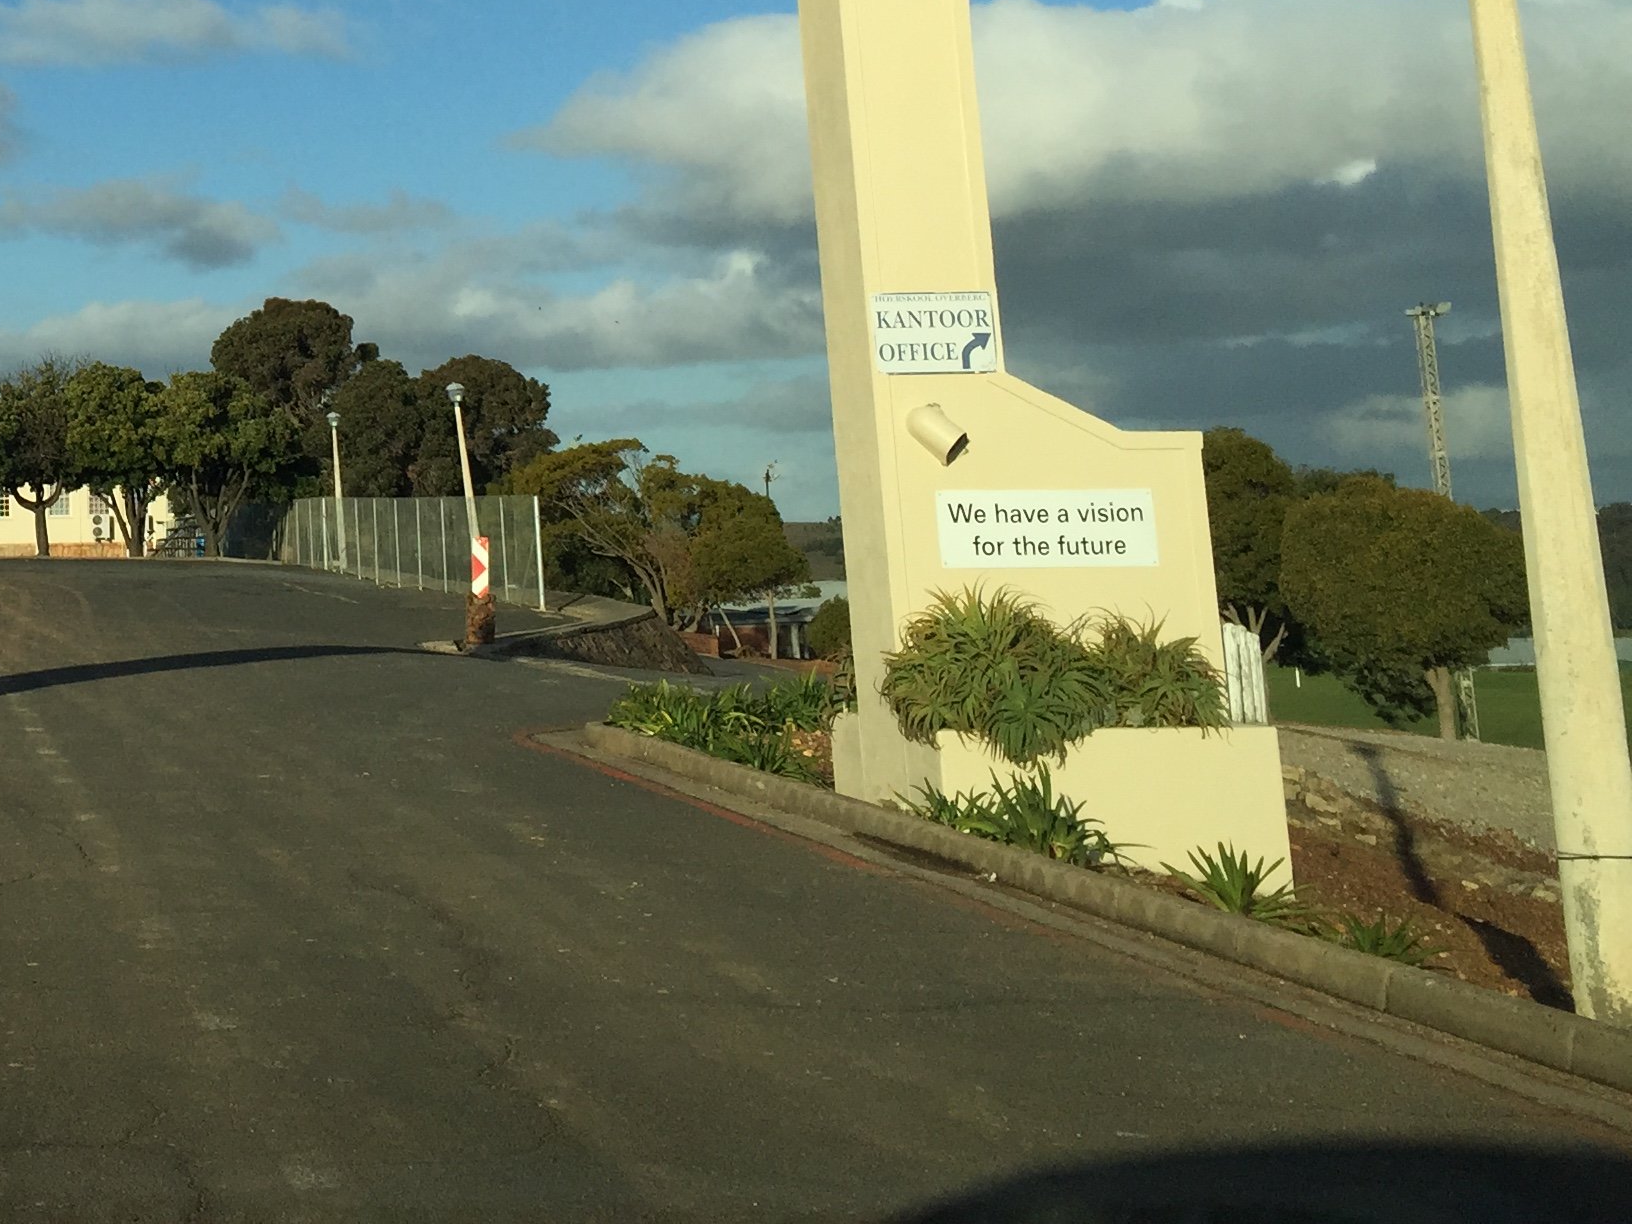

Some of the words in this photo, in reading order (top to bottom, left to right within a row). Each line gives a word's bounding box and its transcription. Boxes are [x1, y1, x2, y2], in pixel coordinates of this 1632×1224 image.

[876, 309, 990, 329] KANTOOR
[879, 342, 959, 362] OFFICE
[948, 504, 985, 523] We
[995, 504, 1048, 523] have
[1058, 509, 1068, 523] a
[1077, 502, 1143, 522] vision
[973, 536, 1004, 555] for
[1013, 536, 1049, 555] the
[1058, 535, 1125, 555] future
